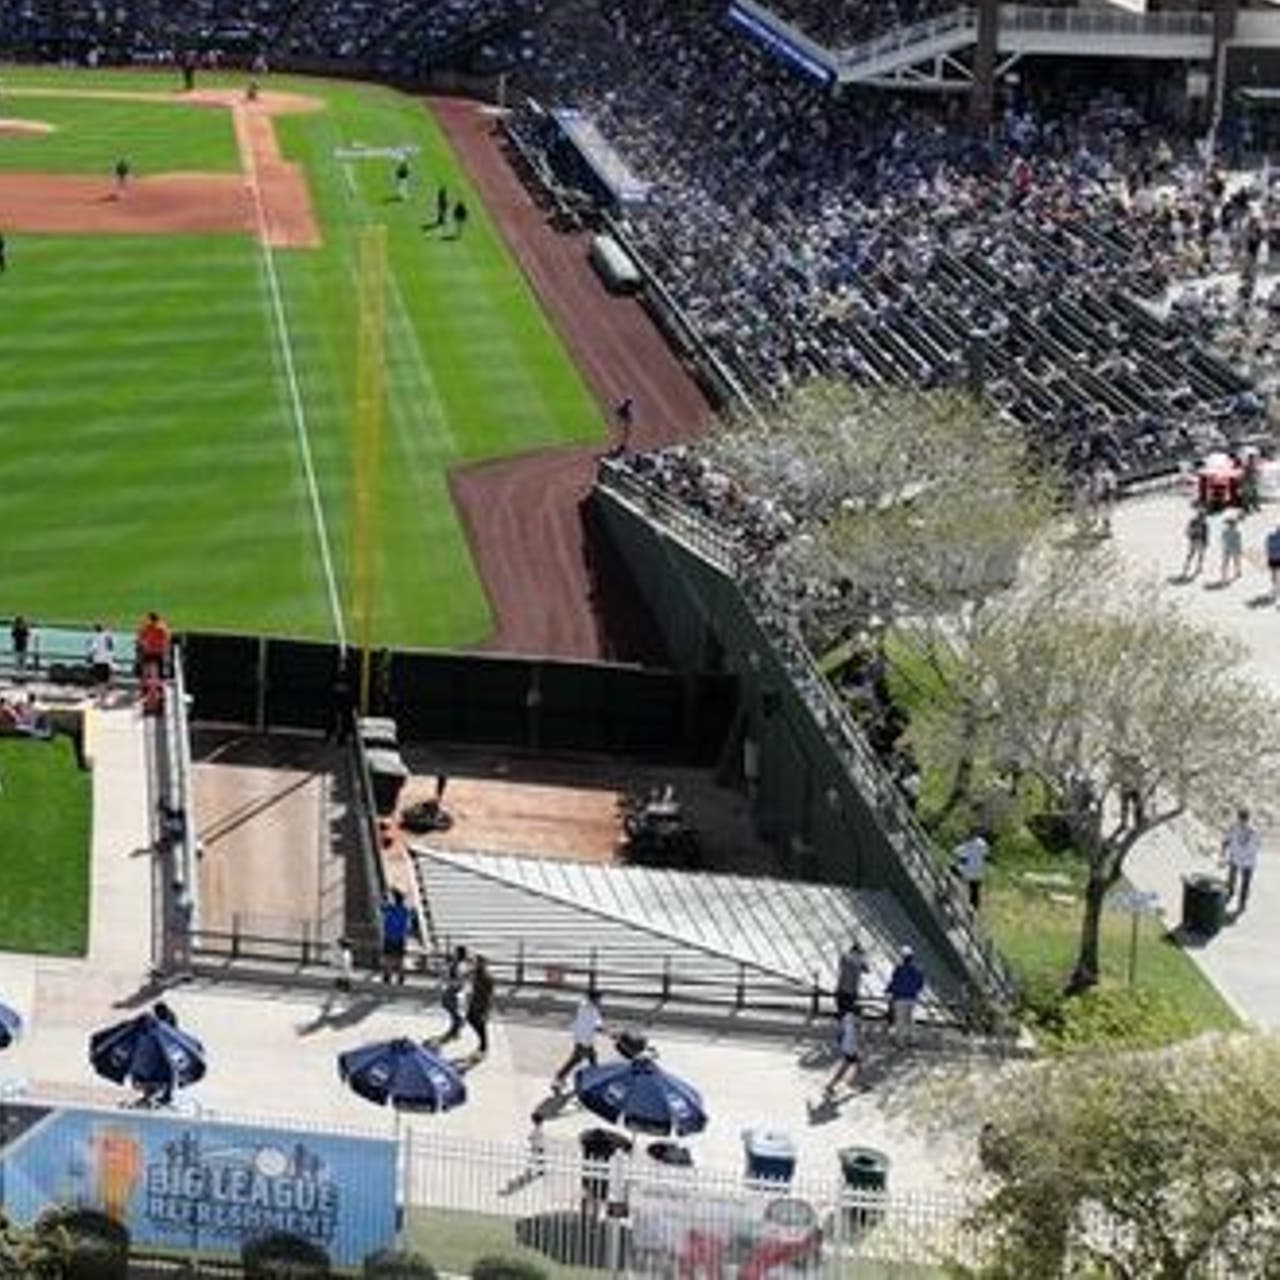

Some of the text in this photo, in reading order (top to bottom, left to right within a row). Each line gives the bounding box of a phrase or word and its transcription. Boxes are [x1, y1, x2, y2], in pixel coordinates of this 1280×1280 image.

[148, 1160, 338, 1214] BIG LEAGUE
[148, 1196, 336, 1238] REFRESHMENT
